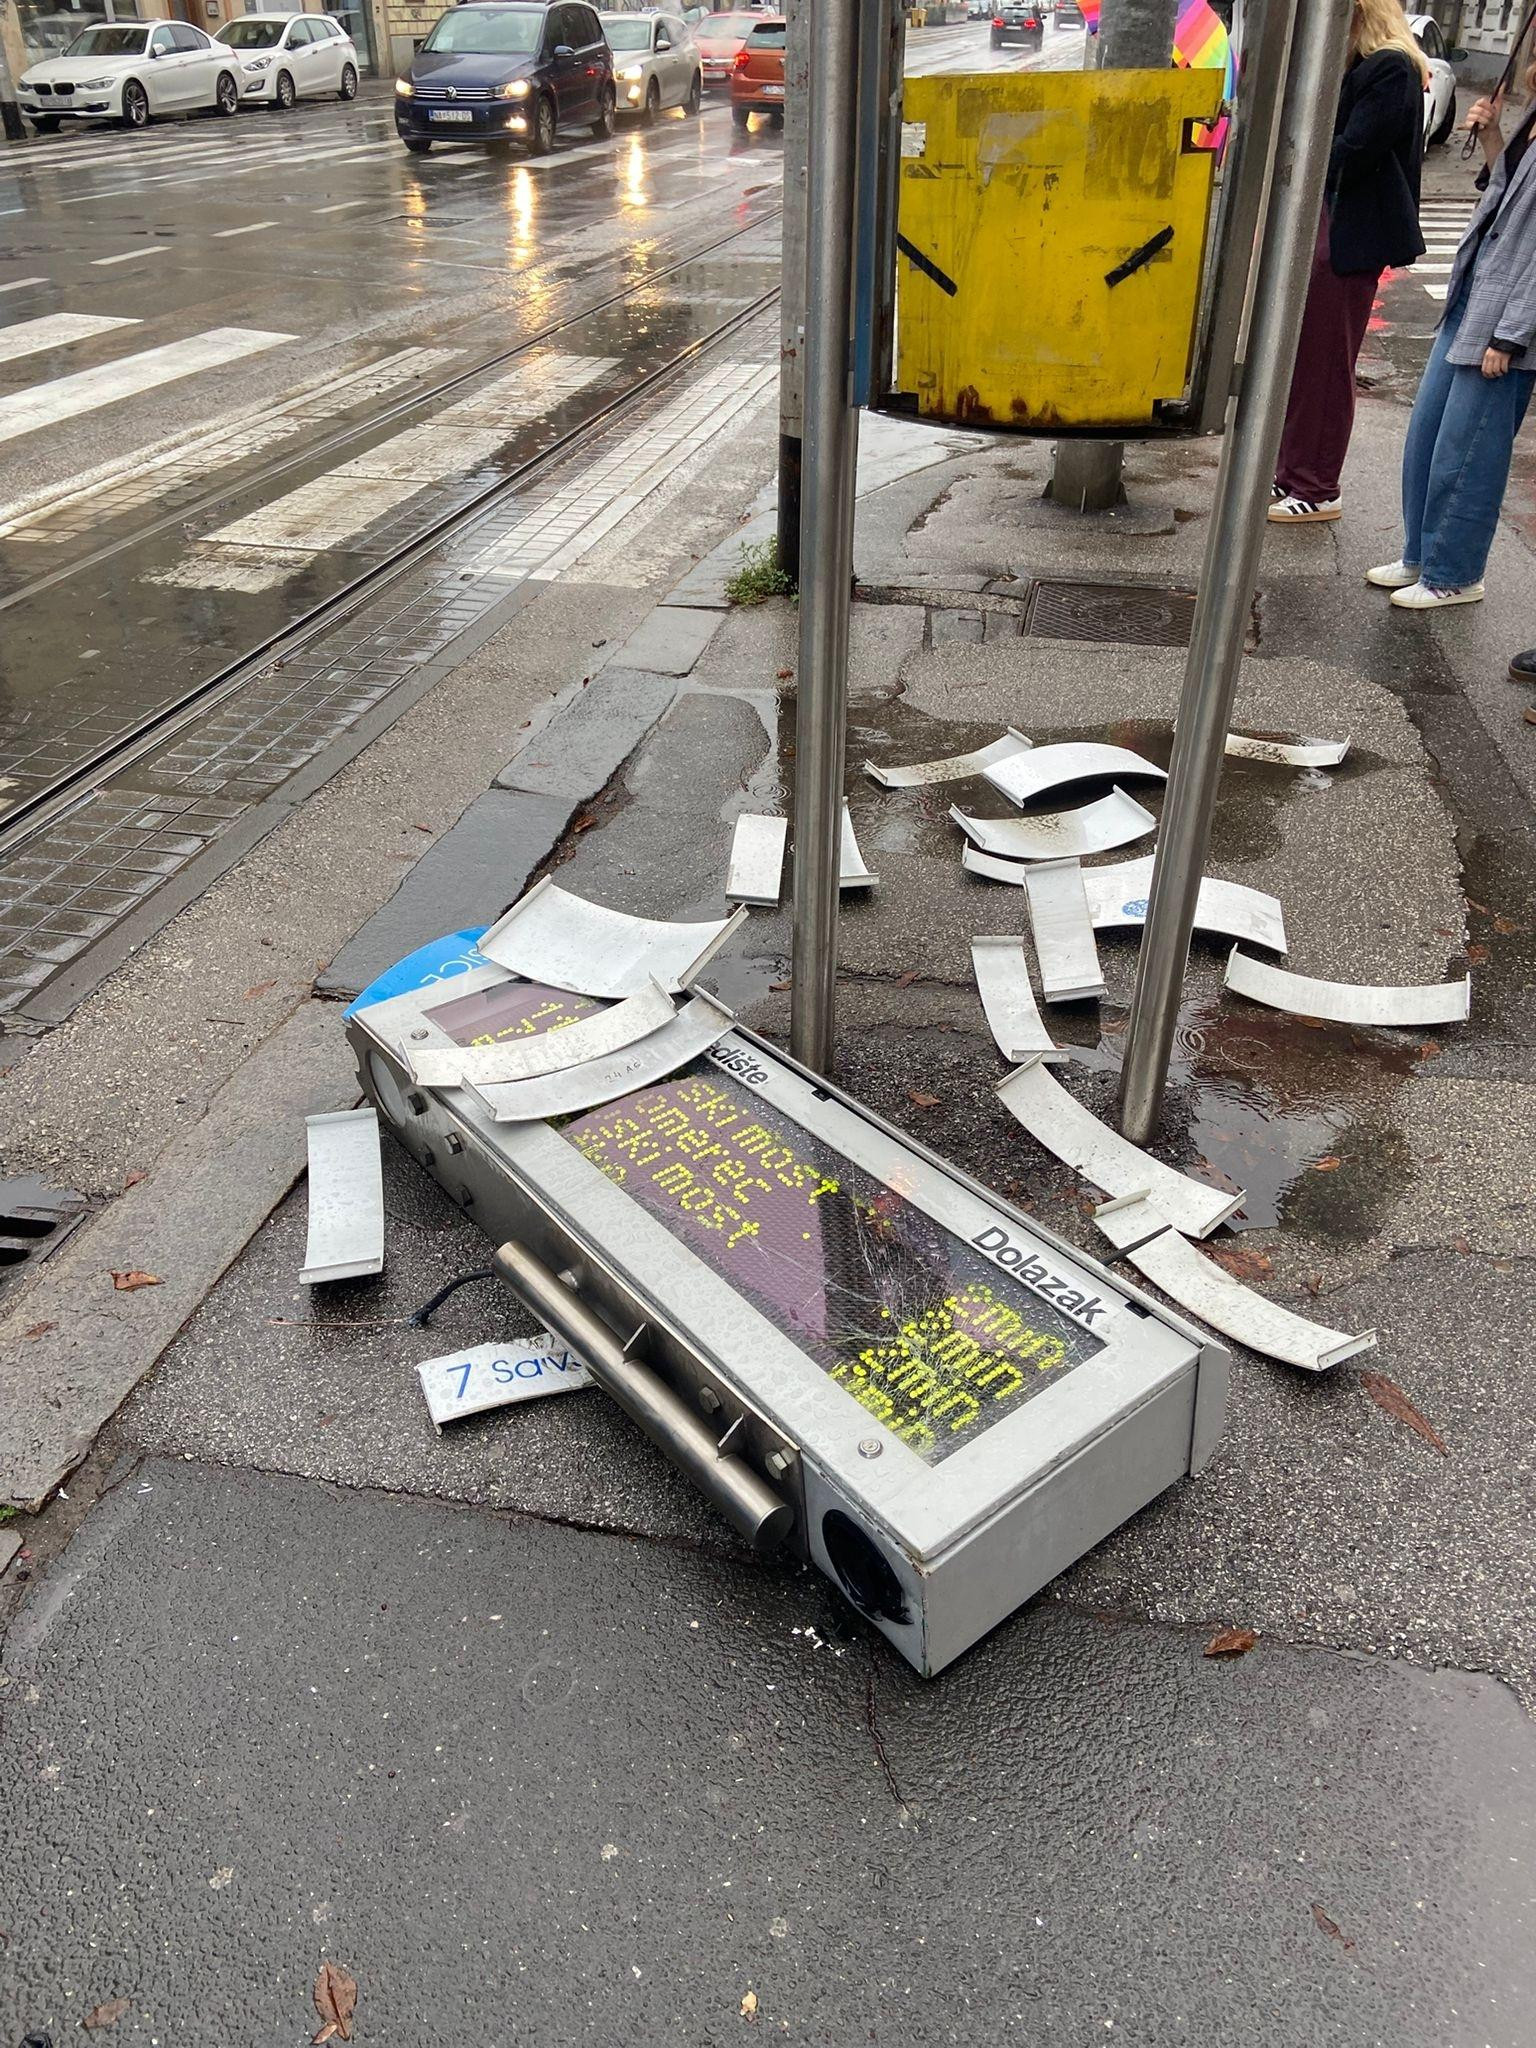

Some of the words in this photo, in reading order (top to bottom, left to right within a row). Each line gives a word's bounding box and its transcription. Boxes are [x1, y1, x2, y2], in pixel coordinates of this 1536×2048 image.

[599, 1118, 673, 1166] ski
[651, 1162, 760, 1249] most
[634, 1095, 772, 1204] omerec
[676, 1083, 749, 1128] ski
[731, 1124, 841, 1205] most
[971, 1225, 1107, 1326] Dolazak
[446, 1363, 472, 1399] 7
[491, 1351, 583, 1384] Sav
